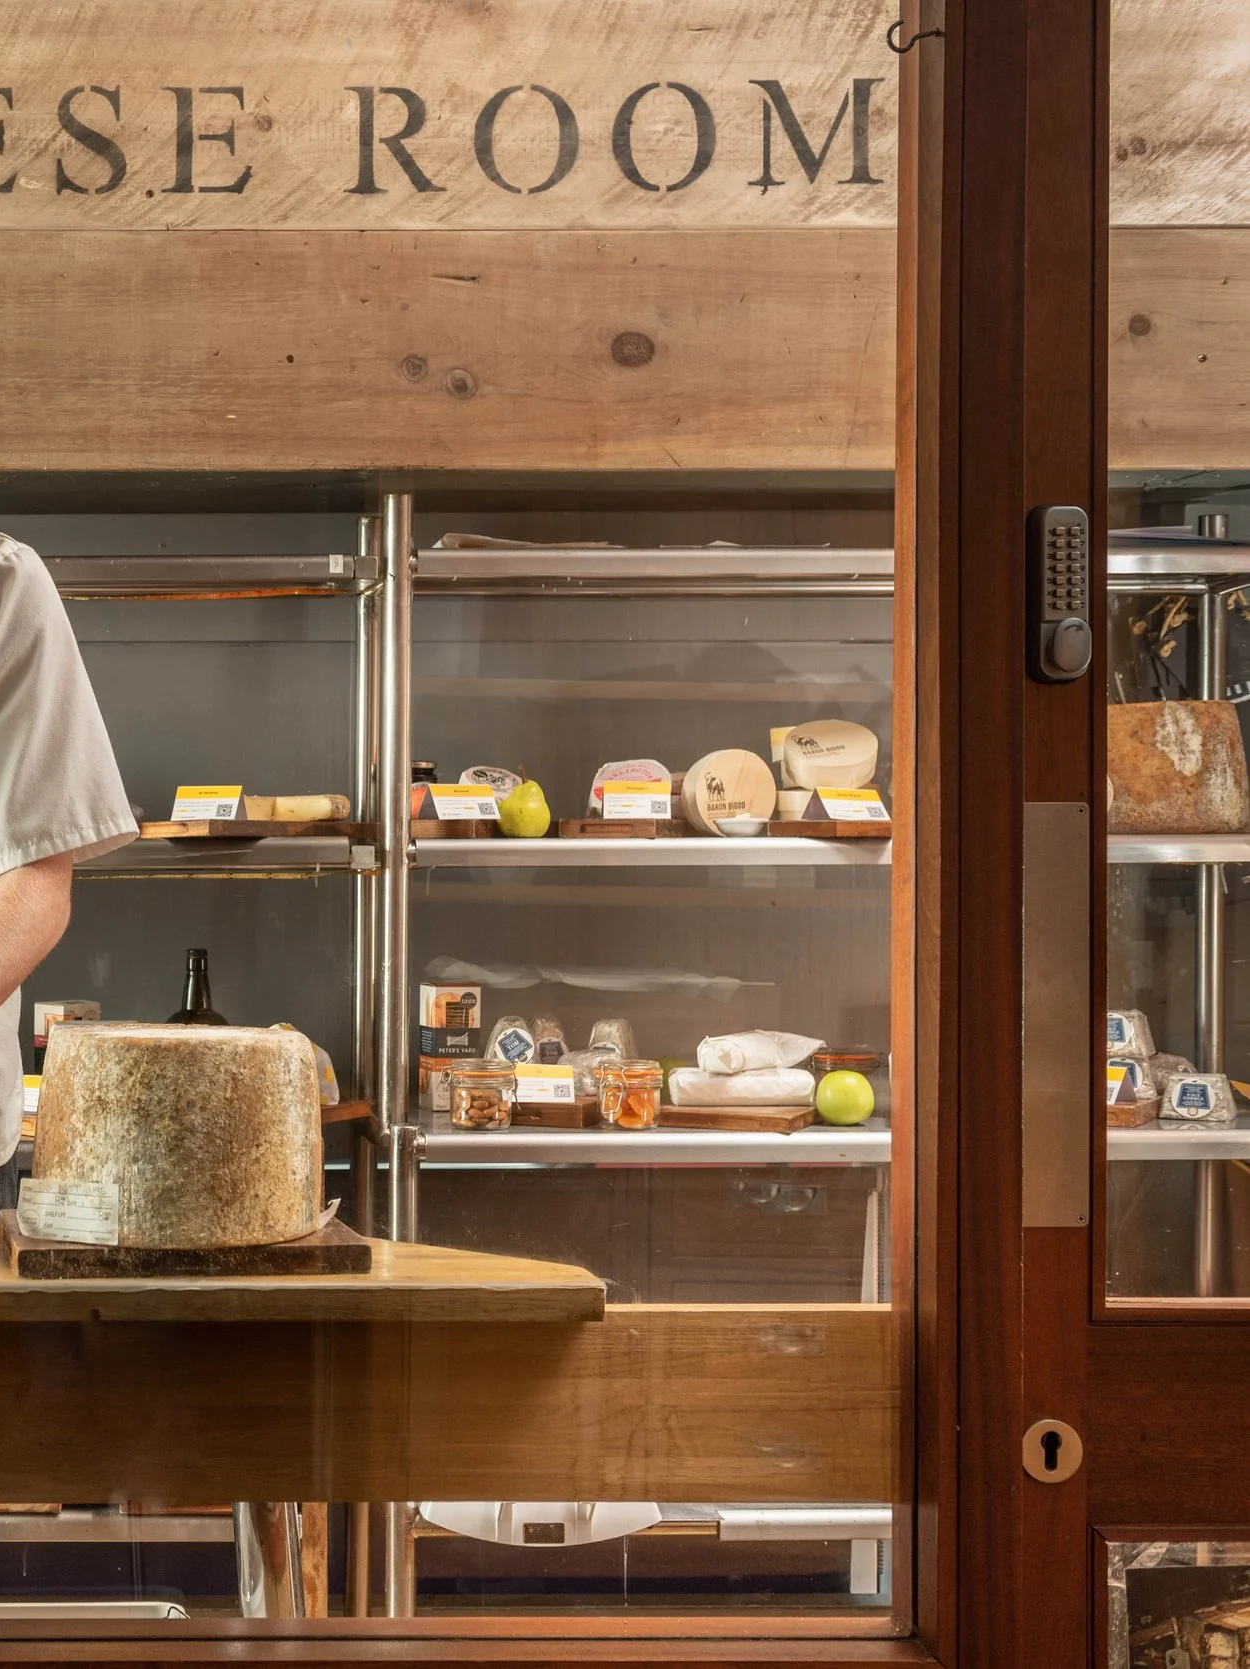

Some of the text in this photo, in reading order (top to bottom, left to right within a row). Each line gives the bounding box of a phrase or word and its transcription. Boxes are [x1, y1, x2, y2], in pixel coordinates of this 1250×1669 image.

[342, 77, 886, 195] ROOM
[802, 748, 825, 756] BARON
[707, 801, 746, 812] BARON BIGOD
[507, 1039, 520, 1051] TOR
